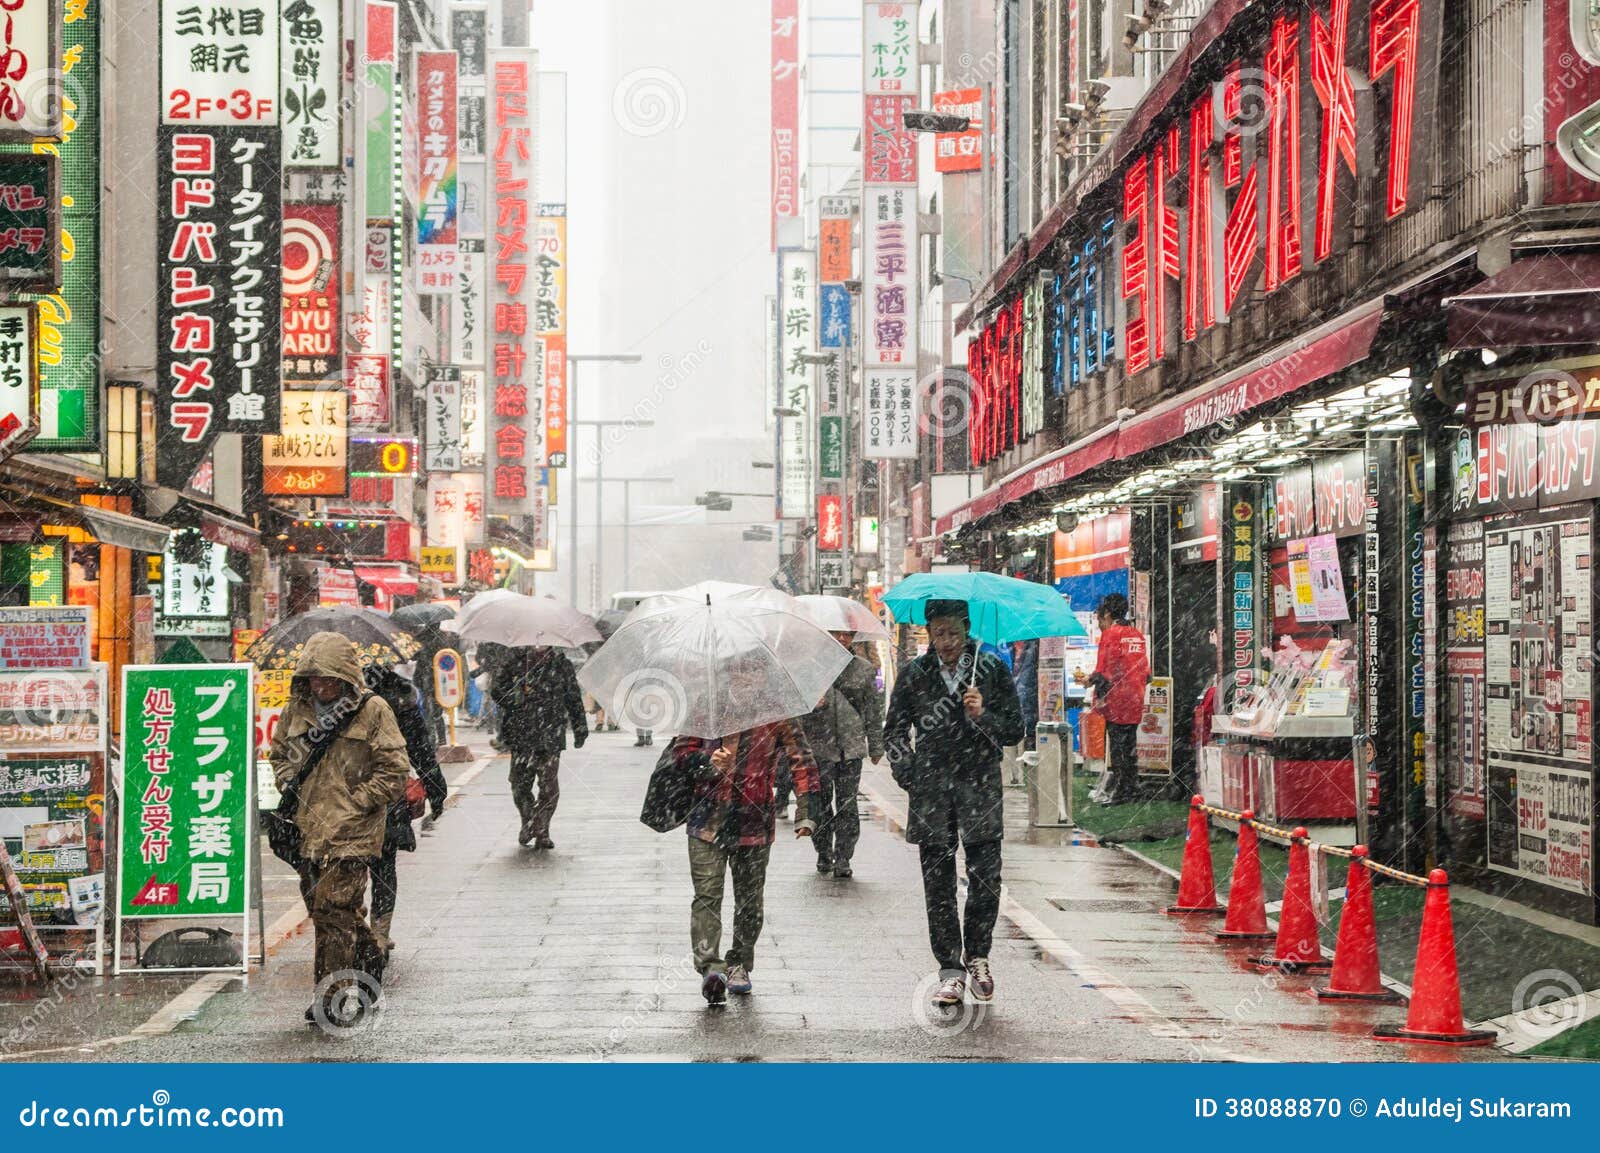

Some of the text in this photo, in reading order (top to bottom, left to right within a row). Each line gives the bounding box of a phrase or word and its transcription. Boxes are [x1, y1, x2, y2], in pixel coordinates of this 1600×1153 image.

[175, 6, 265, 37] 三代目
[0, 0, 27, 121] ーめん
[190, 43, 250, 73] 網元
[872, 43, 889, 78] ホール
[422, 70, 452, 231] カメラのキタムラ
[1123, 0, 1421, 376] ヨドバシカメラ
[420, 252, 456, 266] カメラ
[168, 133, 217, 443] ヨドバシカメラ
[227, 137, 266, 421] ケータイアクセサリー館
[422, 273, 454, 288] 時計
[284, 310, 331, 331] JYU
[0, 316, 24, 388] 手打ち
[283, 332, 332, 353] ARU
[435, 369, 453, 381] 2F
[271, 434, 337, 459] 讃岐うどん
[1477, 424, 1597, 504] ヨドバシカメラ
[141, 686, 175, 865] 処方せん受付
[187, 679, 237, 905] プラザ薬局
[144, 886, 170, 902] 4F
